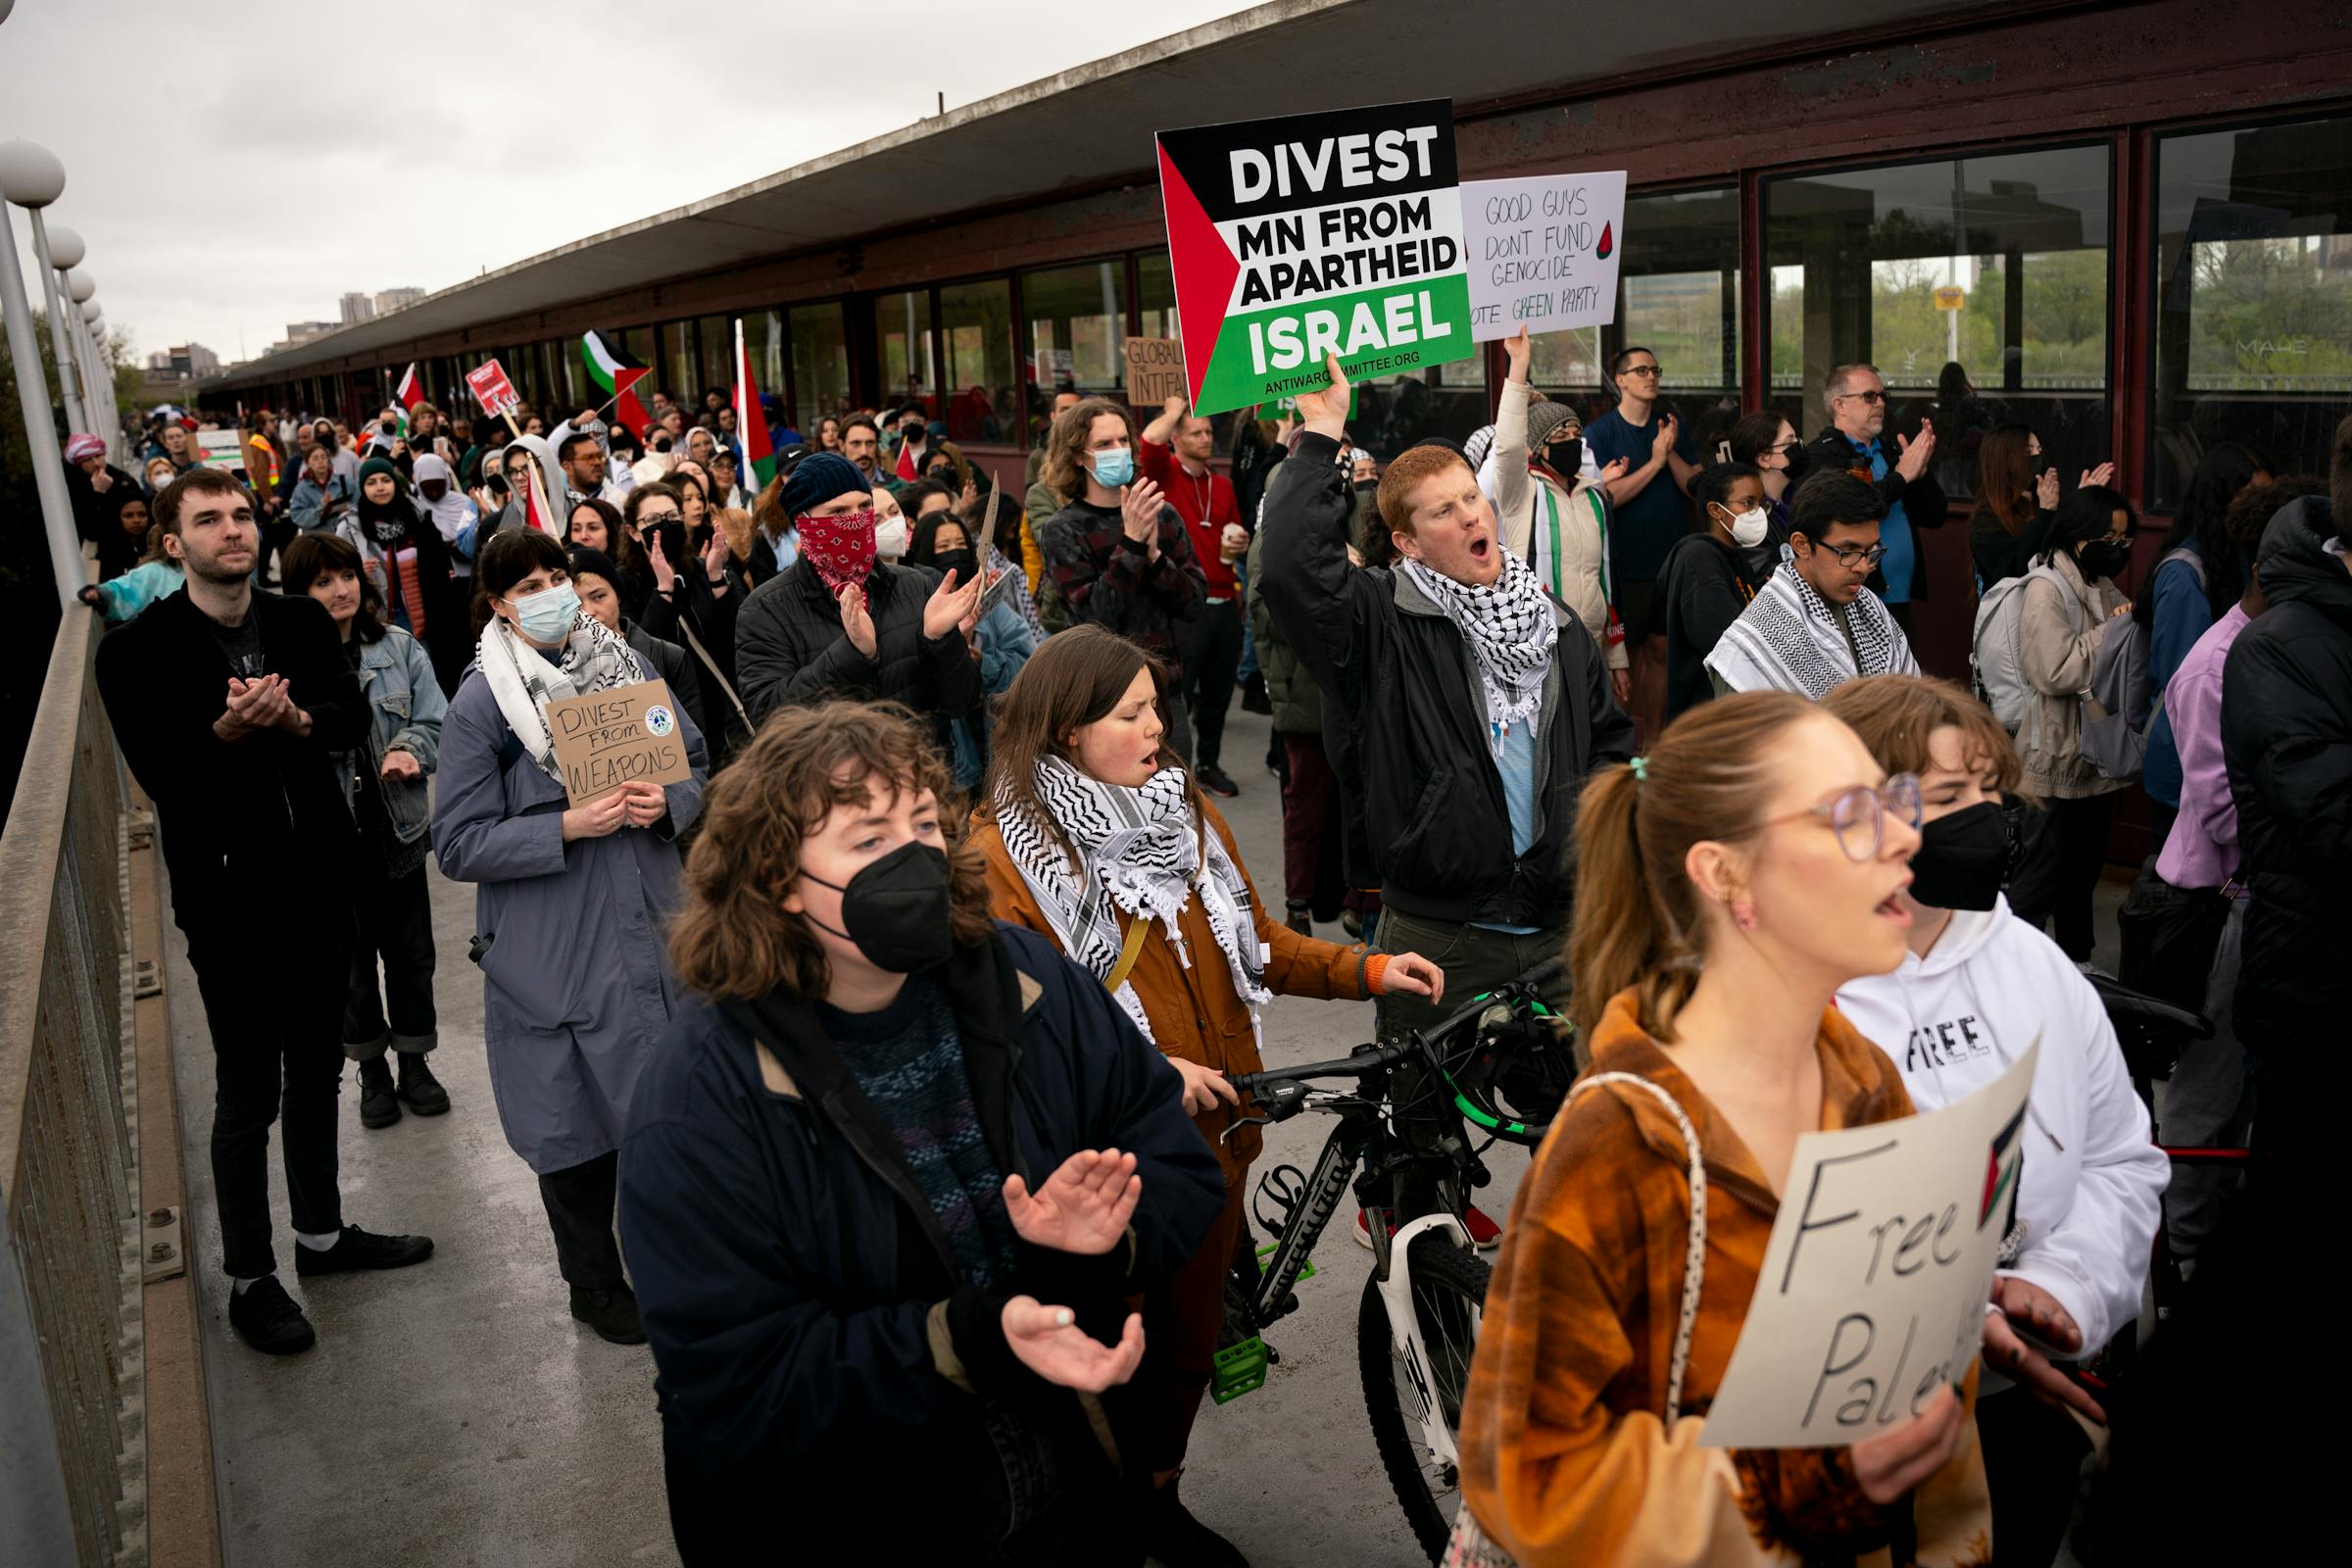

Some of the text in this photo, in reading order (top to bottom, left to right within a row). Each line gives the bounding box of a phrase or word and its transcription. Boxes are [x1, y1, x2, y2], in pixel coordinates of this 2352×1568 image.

[1230, 125, 1438, 204] DIVEST
[1238, 196, 1432, 261] MN FROM
[1486, 187, 1587, 224] GOOD GUYS
[1545, 221, 1592, 254] FUND
[1241, 236, 1457, 306] APARTHEID
[1492, 255, 1575, 286] GENOCIDE
[1470, 285, 1599, 325] OTE GREEN PARTY
[1249, 290, 1451, 375] ISRAEL
[1135, 372, 1189, 403] INTIFA
[1265, 351, 1420, 395] ANTIWARCMMITTEE.ORG
[557, 698, 635, 734] DIVEST
[567, 746, 677, 795] WEAPONS
[1906, 1014, 1990, 1072] FREE
[1780, 1140, 1963, 1295] Free
